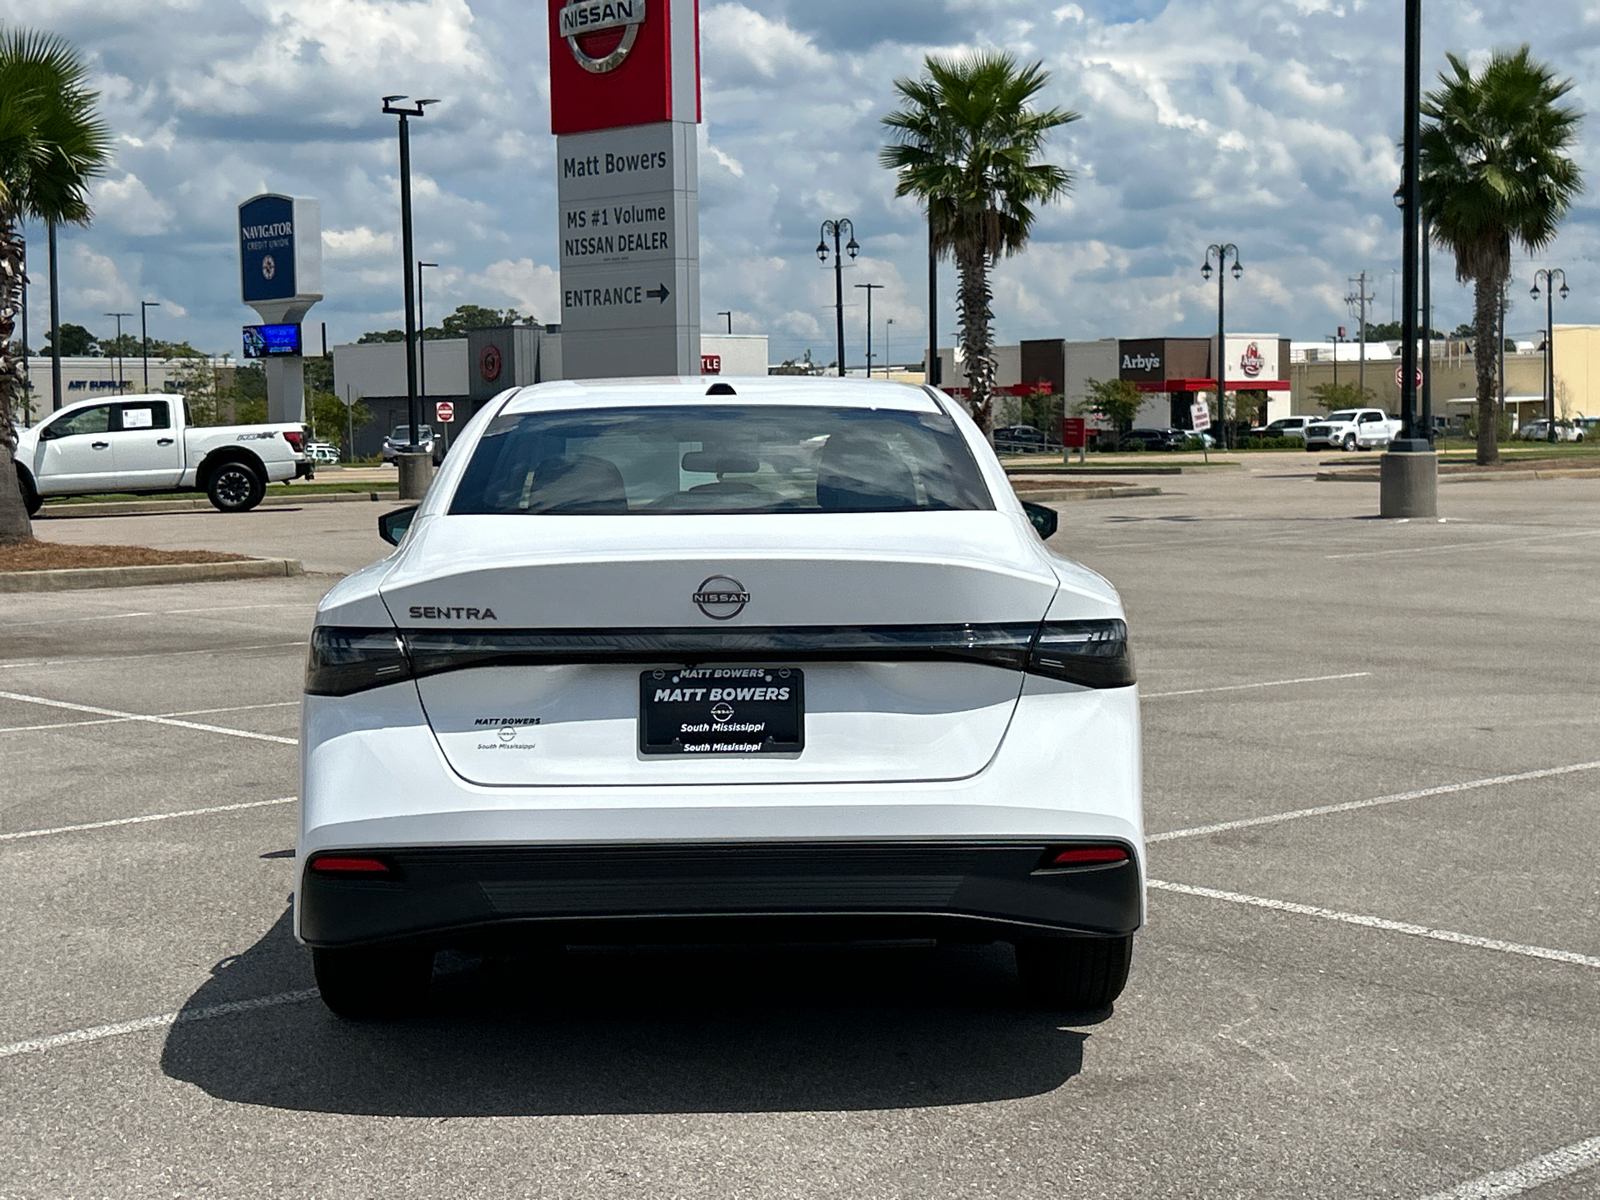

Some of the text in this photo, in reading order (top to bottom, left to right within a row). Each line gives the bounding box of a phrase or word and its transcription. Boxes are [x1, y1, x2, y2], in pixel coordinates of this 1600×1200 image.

[564, 0, 633, 30] NISSAN
[564, 151, 667, 178] Matt Bowers
[567, 205, 666, 229] MS #1 Volume
[242, 221, 292, 240] NAVIGATOR
[247, 238, 290, 250] CREDIT UNION
[565, 231, 668, 257] NISSAN DEALER
[565, 286, 642, 308] ENTRANCE
[1121, 353, 1160, 371] Arby's
[694, 593, 749, 602] NISSAN
[409, 606, 497, 620] SENTRA
[679, 668, 765, 678] MATT BOWERS
[654, 687, 790, 702] MATT BOWERS
[501, 717, 541, 725] BOWERS
[681, 722, 765, 733] South Mississippi
[683, 742, 762, 753] South Mississippi
